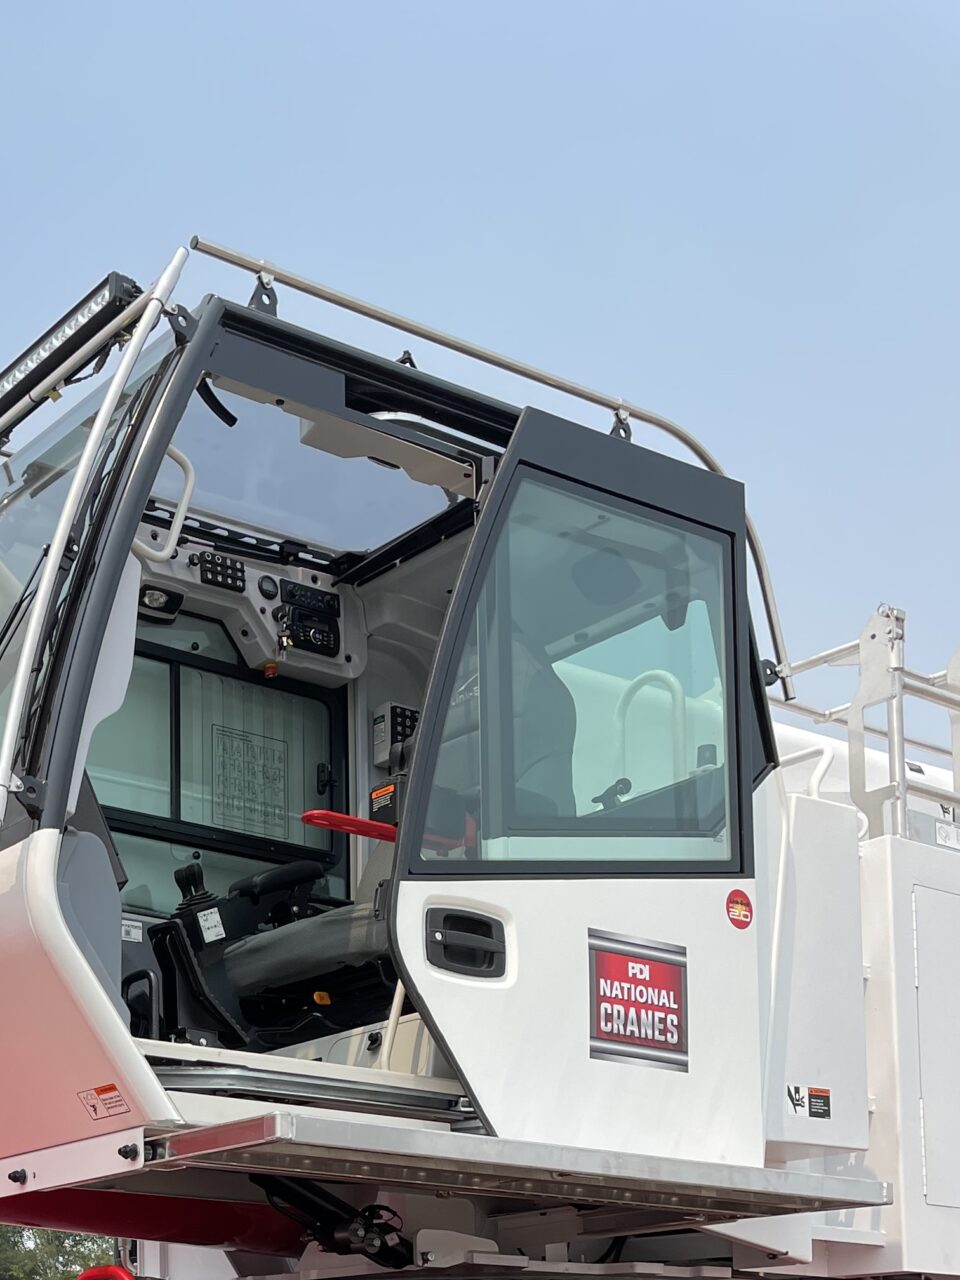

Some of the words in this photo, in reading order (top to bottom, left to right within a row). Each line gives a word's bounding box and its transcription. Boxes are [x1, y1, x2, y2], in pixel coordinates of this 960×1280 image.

[628, 961, 650, 981] PDI
[600, 978, 679, 1009] NATIONAL
[600, 1002, 679, 1044] CRANES
